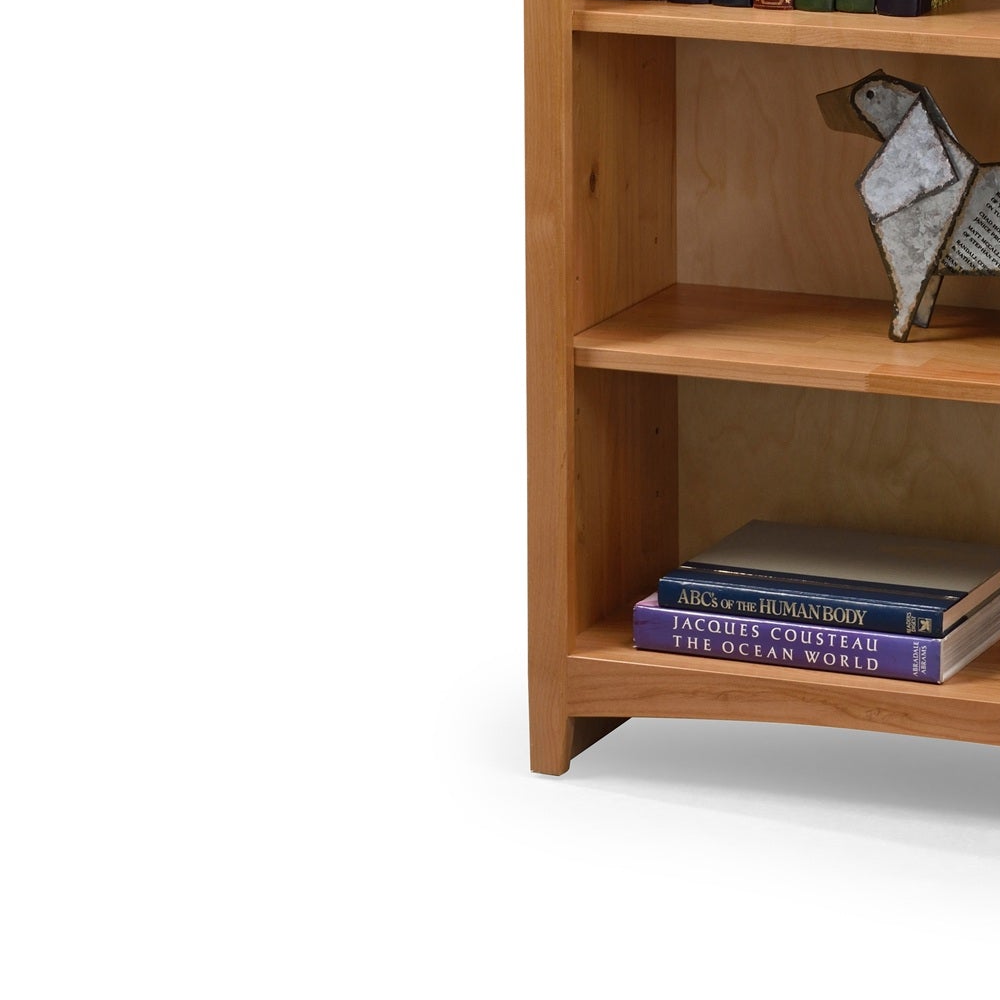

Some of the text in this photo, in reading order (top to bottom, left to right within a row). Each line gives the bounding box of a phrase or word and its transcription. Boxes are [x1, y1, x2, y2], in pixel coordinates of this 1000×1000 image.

[985, 202, 995, 211] ON
[990, 197, 999, 205] OF
[974, 216, 992, 234] JANICE
[978, 210, 994, 226] CHAD
[967, 225, 983, 240] MATT
[962, 230, 971, 239] OF
[968, 236, 993, 260] STEPHAN
[677, 588, 868, 626] ABC's OF THE HUMAN BODY
[672, 615, 879, 652] JACQUES COUSTEAU
[672, 634, 879, 671] THE OCEAN WORLD
